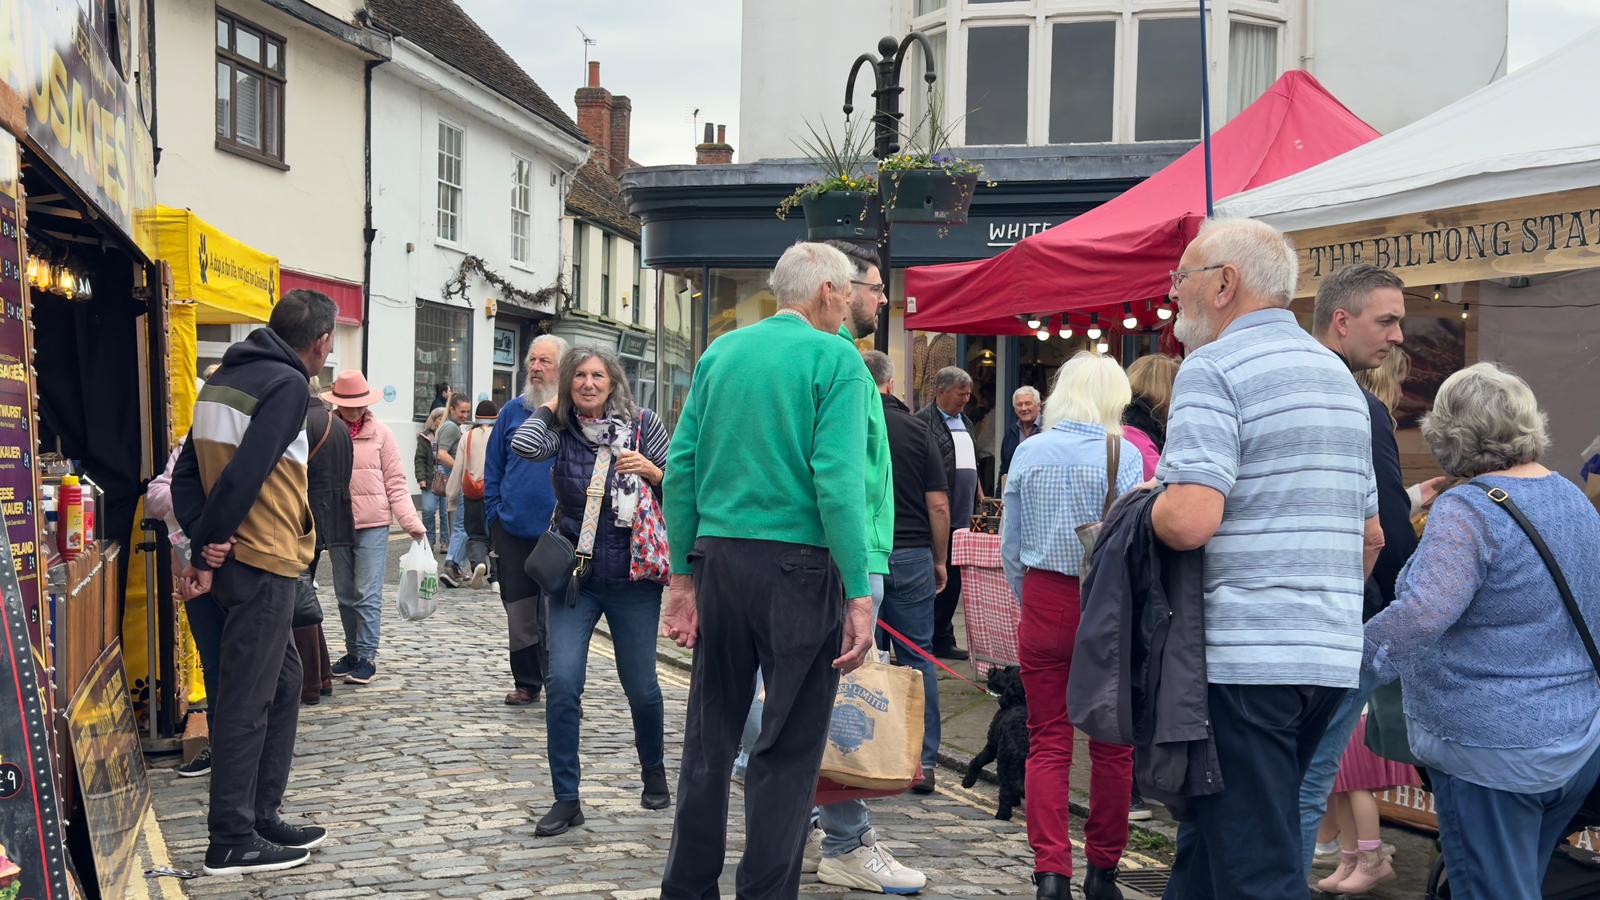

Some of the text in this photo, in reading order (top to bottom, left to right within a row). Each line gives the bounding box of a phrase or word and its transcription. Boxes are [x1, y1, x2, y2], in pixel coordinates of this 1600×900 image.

[1309, 241, 1364, 277] THE
[1374, 221, 1511, 268] BILTONG
[853, 685, 888, 712] LIMITED
